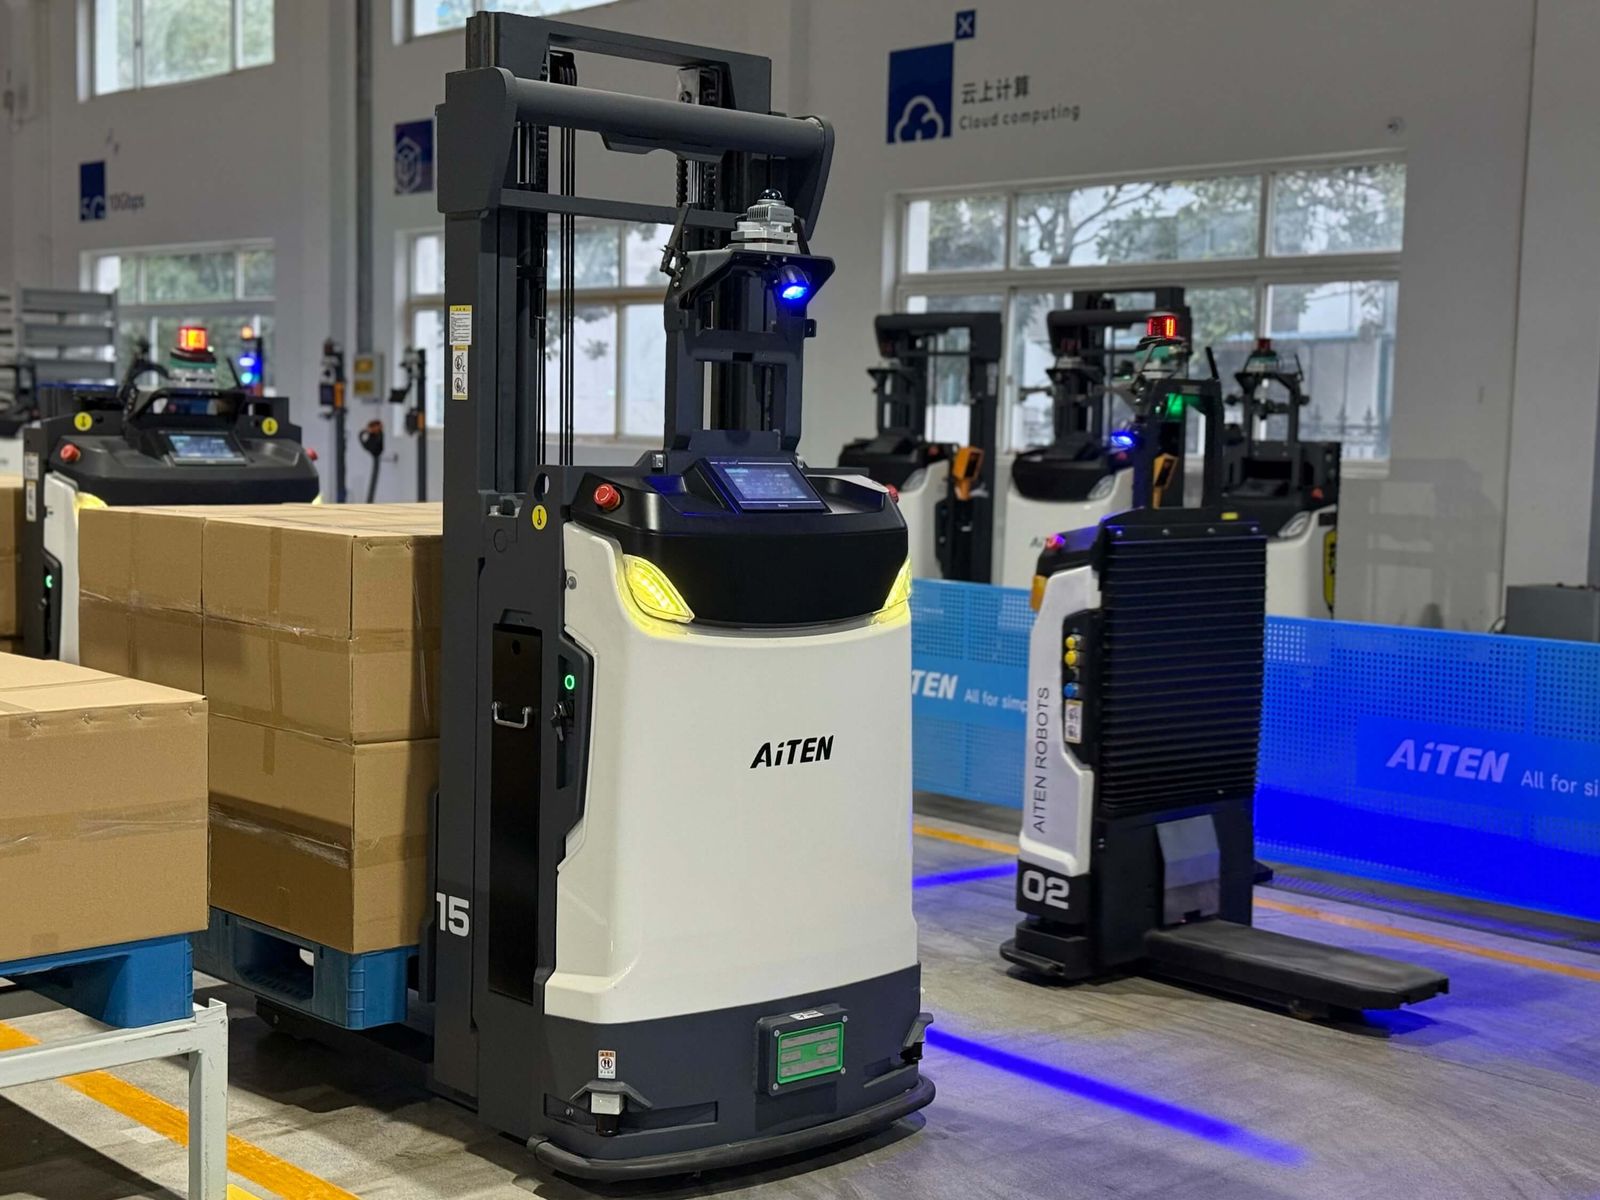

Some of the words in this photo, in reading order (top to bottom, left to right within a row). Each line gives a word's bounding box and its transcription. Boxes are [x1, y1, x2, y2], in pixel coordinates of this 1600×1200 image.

[962, 75, 1030, 105] 云上计算
[958, 110, 999, 130] Cloud
[1002, 104, 1081, 126] computing
[964, 688, 980, 704] All
[982, 691, 998, 707] for
[1035, 687, 1049, 769] ROBOTS
[750, 735, 834, 769] AiTEN
[1385, 738, 1510, 783] AiTEN
[1521, 770, 1545, 789] All
[1550, 773, 1577, 794] for
[1033, 774, 1048, 834] AITEN
[1022, 870, 1070, 910] 02
[436, 892, 470, 937] 15
